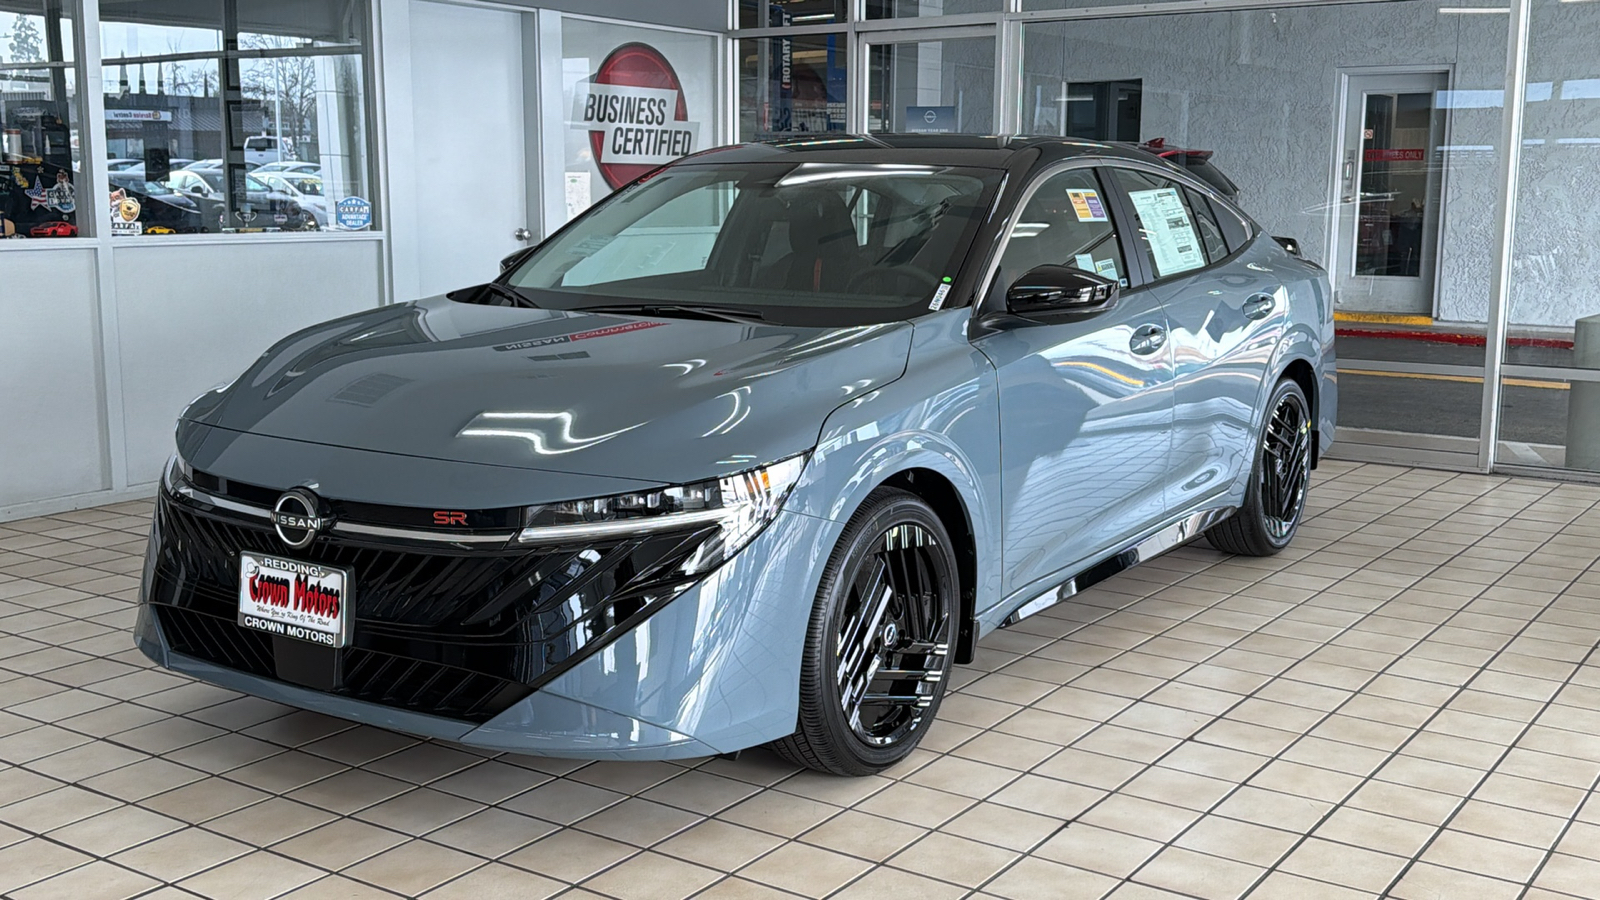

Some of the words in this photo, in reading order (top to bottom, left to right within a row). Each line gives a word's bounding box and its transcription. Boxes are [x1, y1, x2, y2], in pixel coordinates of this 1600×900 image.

[782, 38, 791, 83] ROTARY
[584, 93, 667, 126] BUSINESS
[611, 126, 692, 157] CERTIFIED
[1367, 151, 1404, 160] EYEES
[1404, 151, 1424, 160] ONLY
[111, 222, 140, 231] ARFAX
[271, 512, 317, 529] NISSAN
[433, 511, 469, 526] SR
[264, 557, 319, 577] REDDING
[249, 572, 290, 608] Crown
[294, 573, 340, 620] Motors
[256, 605, 270, 614] Where
[287, 611, 299, 621] King
[299, 614, 307, 623] Of
[307, 616, 316, 624] The
[316, 619, 330, 627] Road
[245, 616, 284, 635] CROWN
[287, 625, 335, 646] MOTORS
